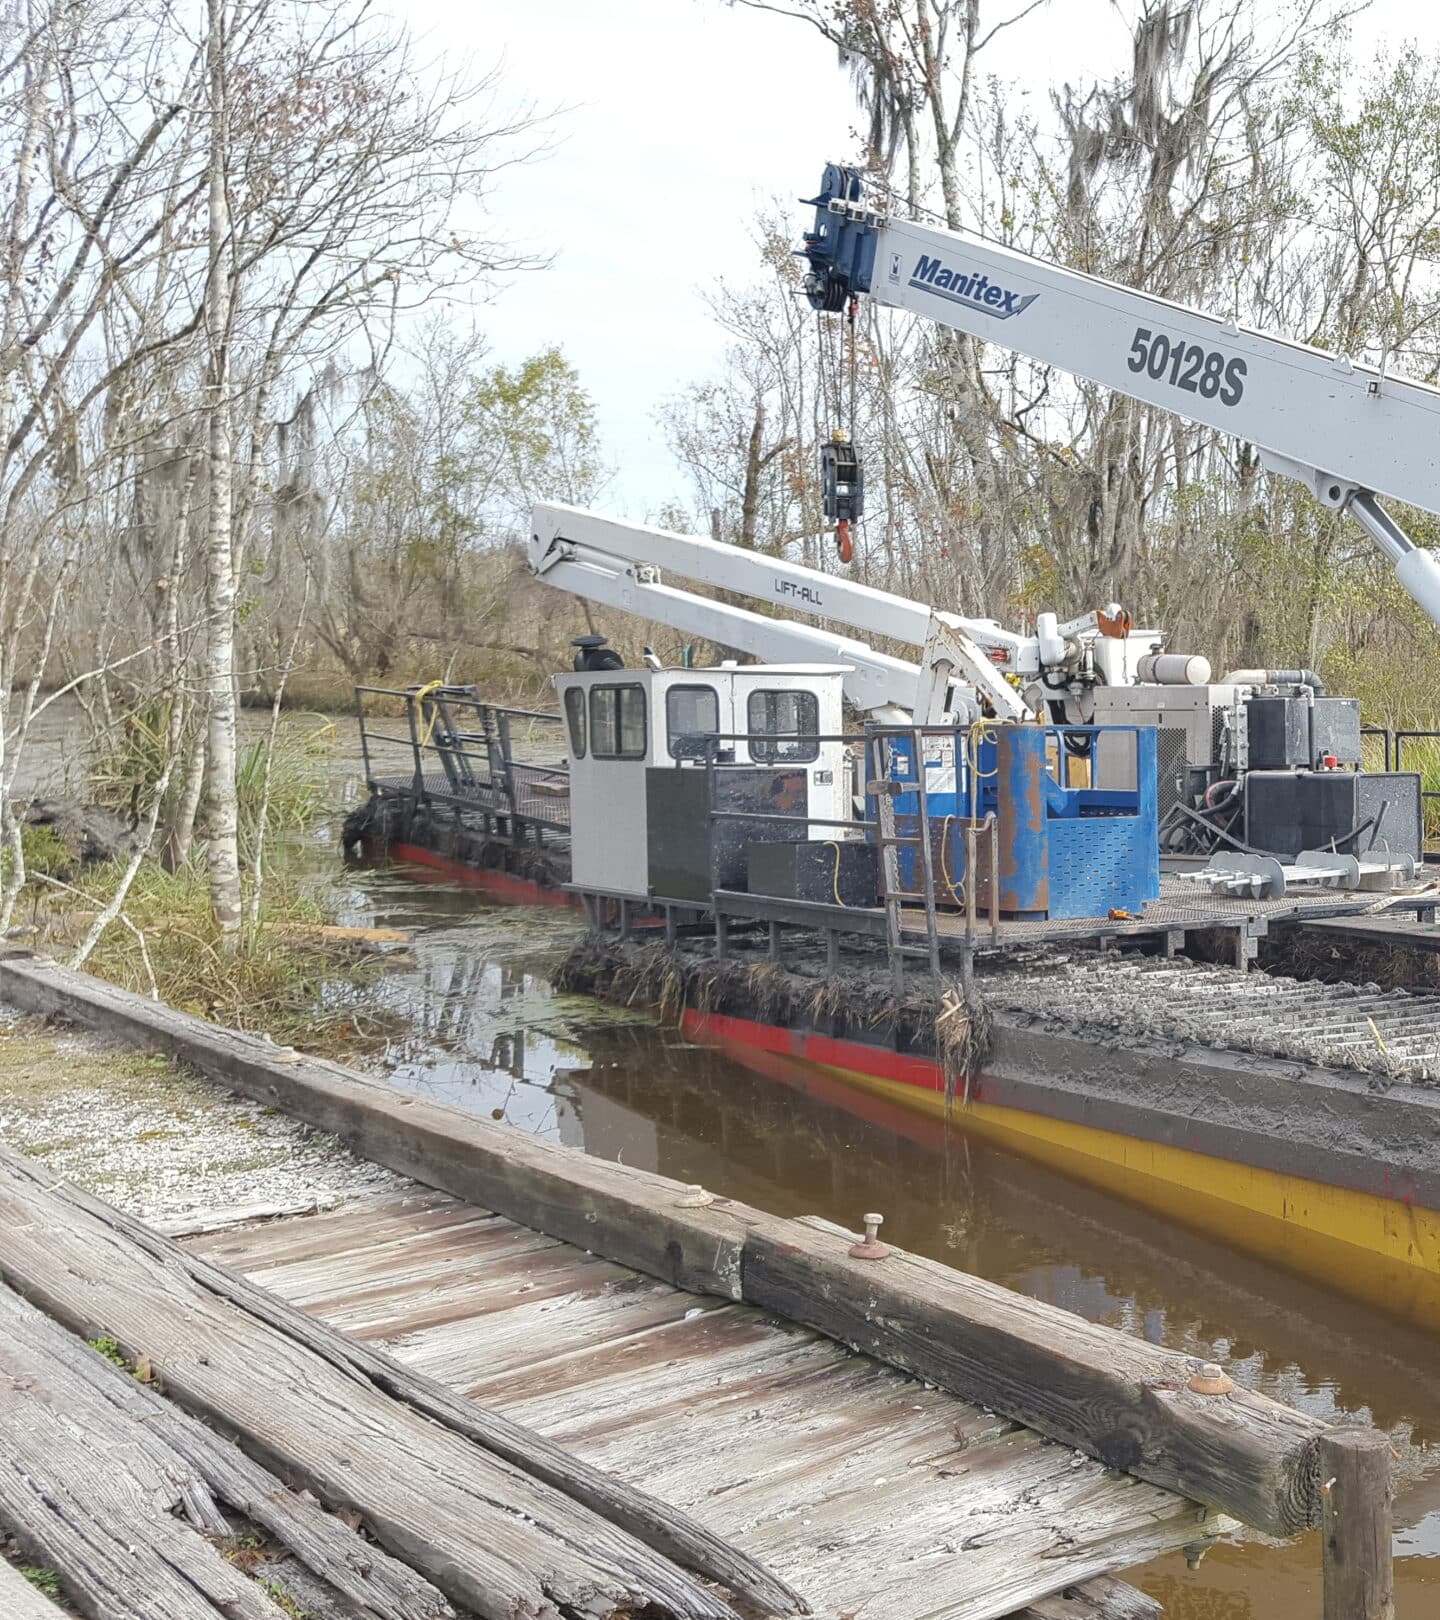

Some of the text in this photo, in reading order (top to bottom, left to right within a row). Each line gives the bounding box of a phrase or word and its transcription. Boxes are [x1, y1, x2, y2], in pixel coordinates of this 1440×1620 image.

[912, 255, 1019, 312] Manitex
[1127, 327, 1247, 407] 50128S
[775, 578, 822, 606] LIFT-ALL
